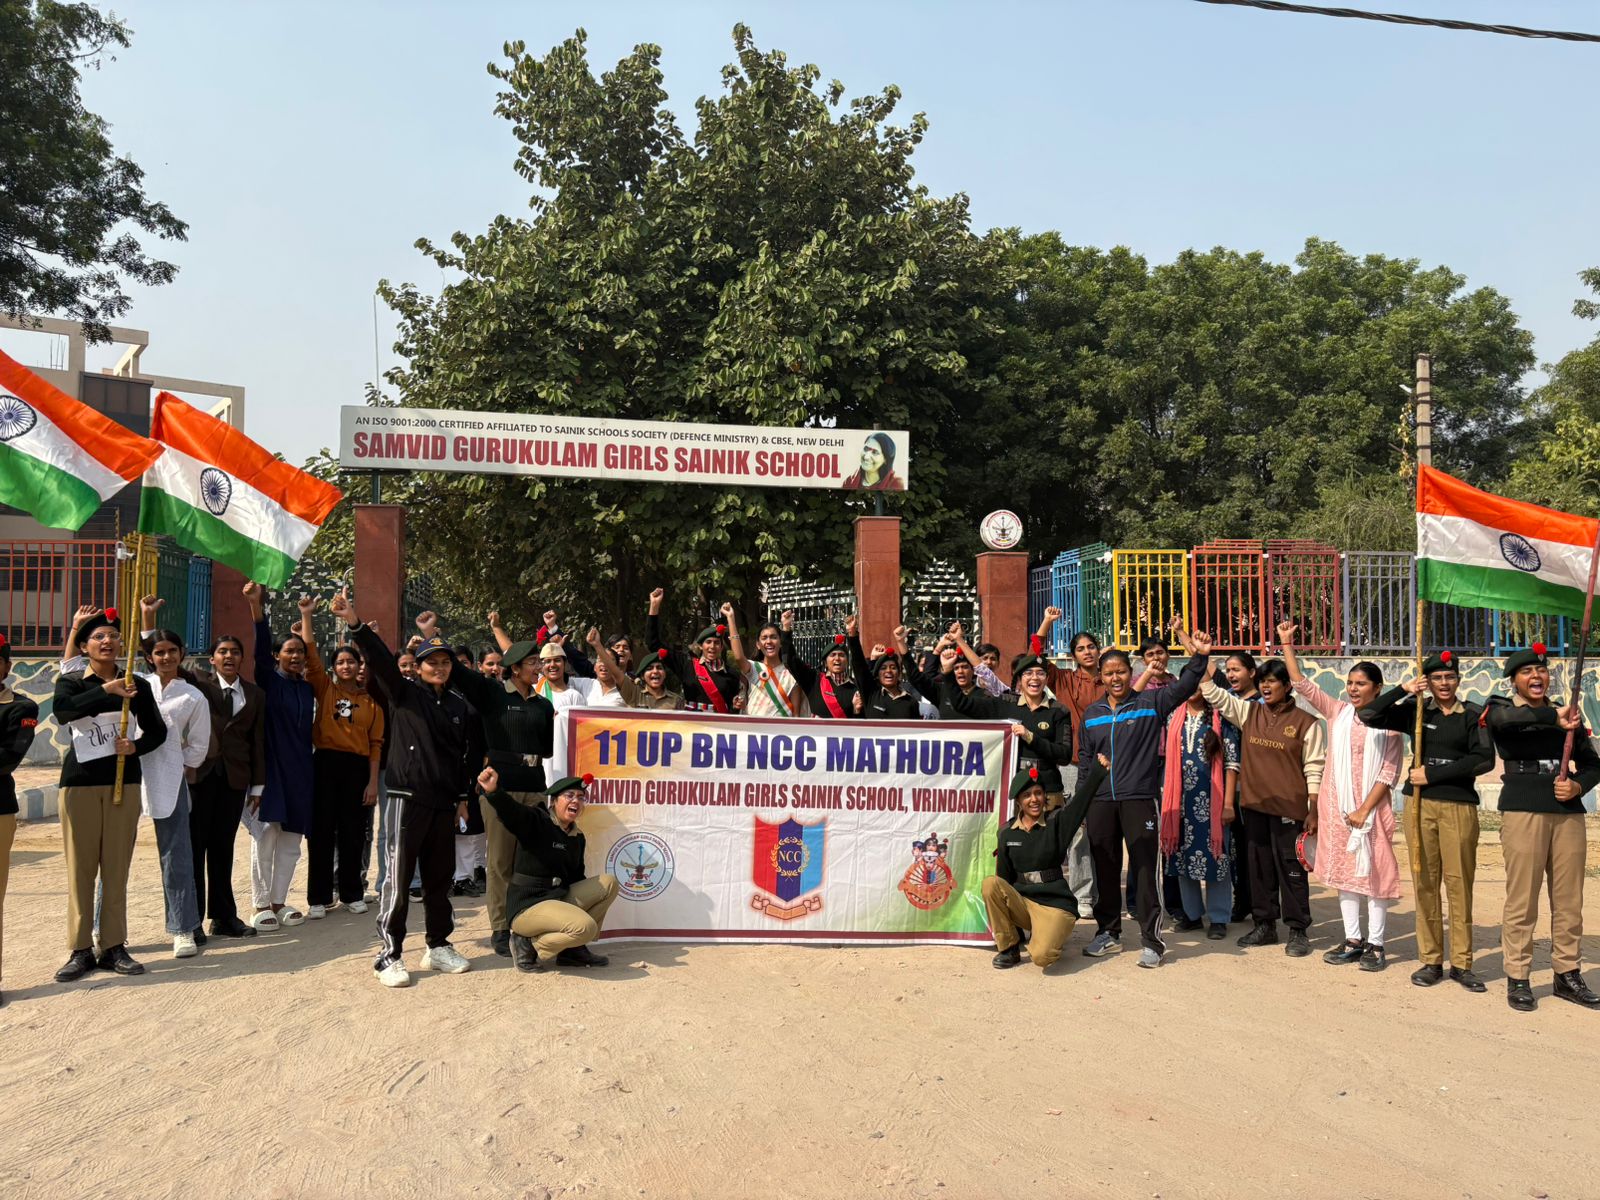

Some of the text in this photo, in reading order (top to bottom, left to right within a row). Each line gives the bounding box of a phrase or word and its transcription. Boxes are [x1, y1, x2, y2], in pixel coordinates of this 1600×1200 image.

[355, 417, 844, 447] AN ISO 9001:2000 CERTIFIED AFFILIATED TO SAINIK SCHOOLS SOCIETY (DEFENCE MINISTRY) & CBSE, NEW DELHI
[353, 431, 841, 478] SAMVID GURUKULAM GIRLS SAINIK SCHOOL
[594, 730, 986, 776] 11 UP BN NCC MATHURA
[1249, 736, 1285, 750] HOUSTON
[645, 780, 740, 807] GURUKULAM
[744, 783, 788, 808] GIRLS
[792, 784, 844, 810] SAINIK
[846, 786, 908, 814] SCHOOL,
[912, 788, 996, 813] VRINDAVAN
[779, 850, 801, 862] NCC
